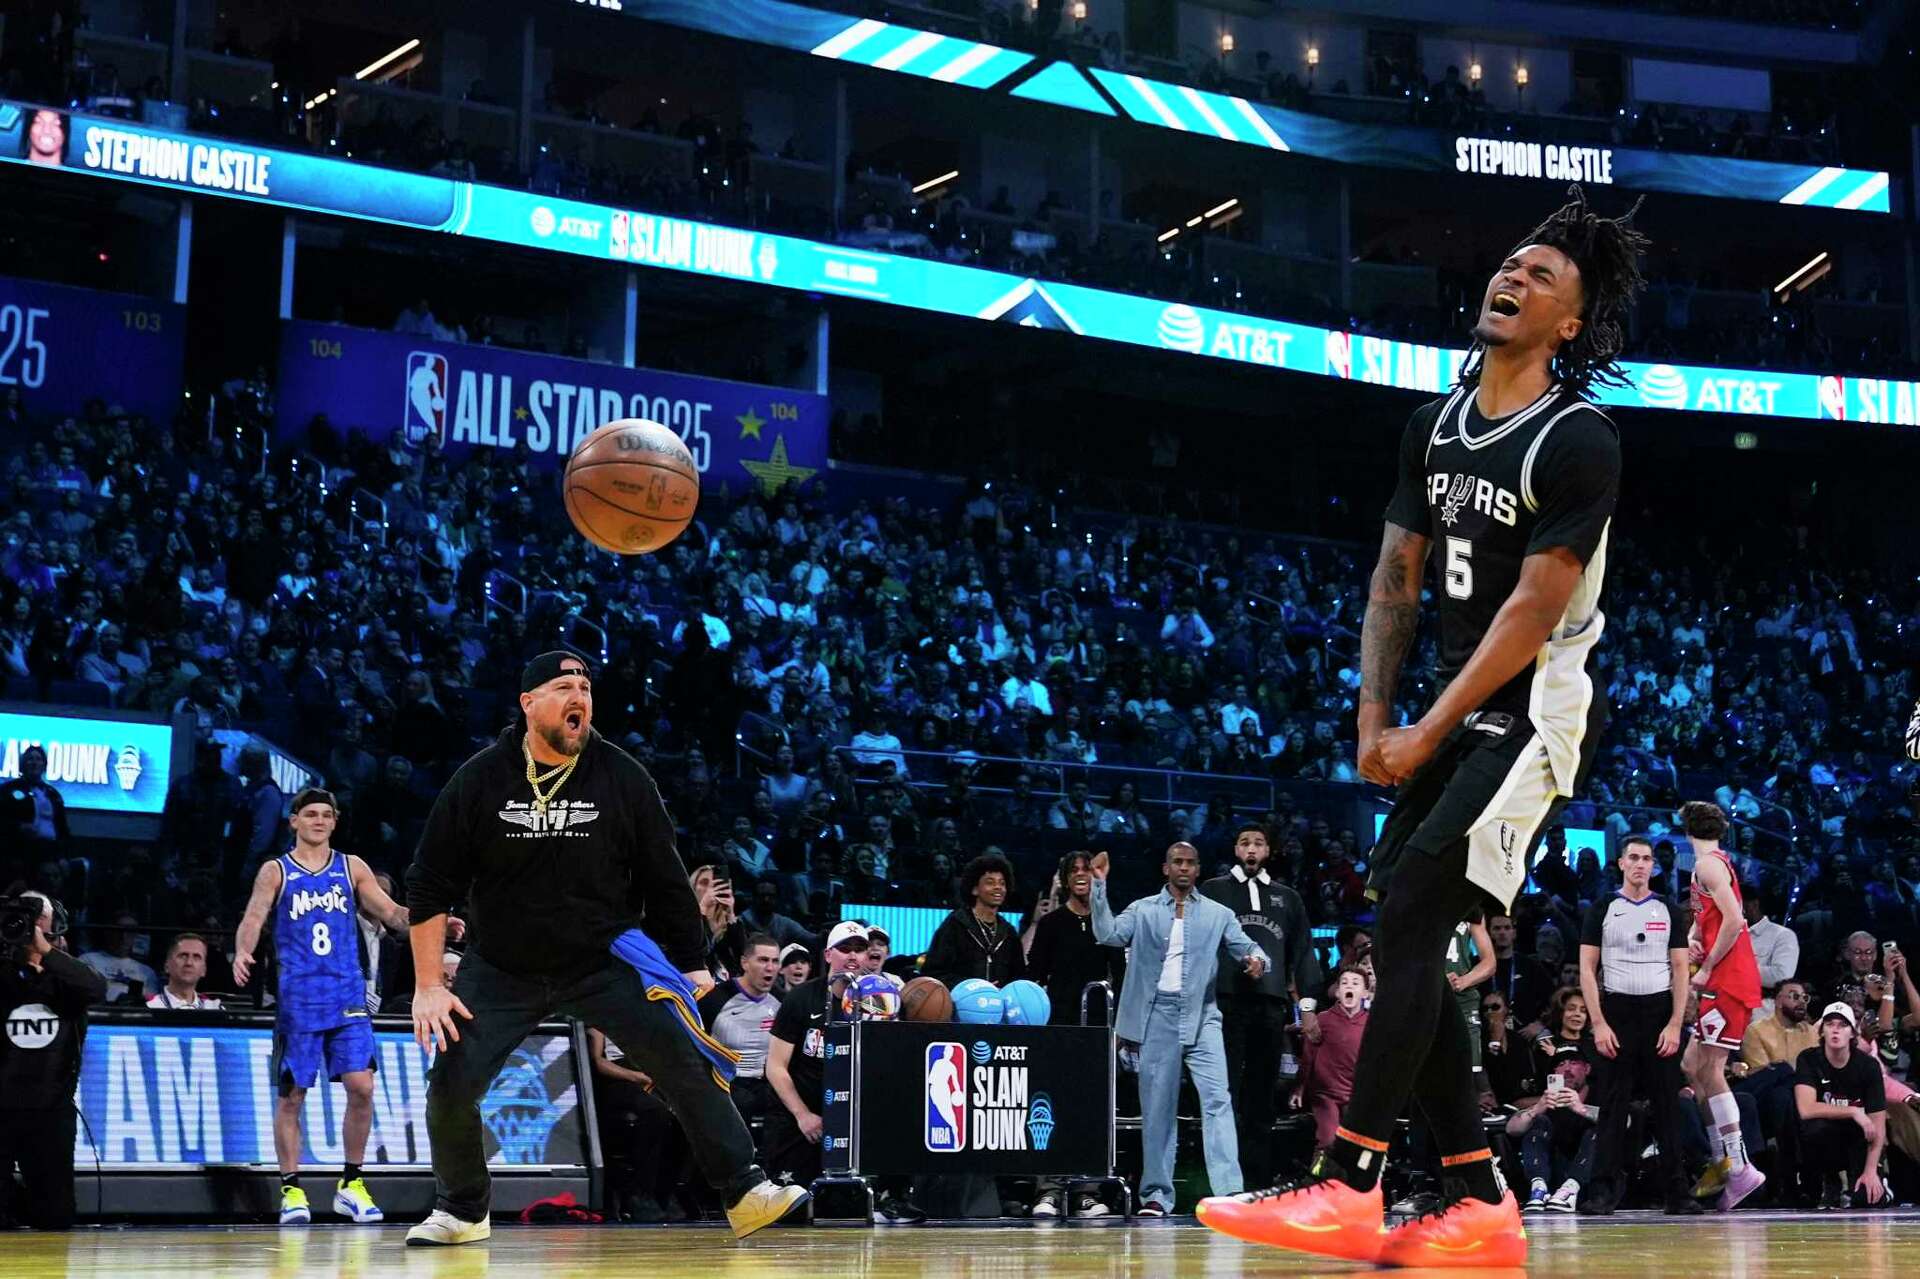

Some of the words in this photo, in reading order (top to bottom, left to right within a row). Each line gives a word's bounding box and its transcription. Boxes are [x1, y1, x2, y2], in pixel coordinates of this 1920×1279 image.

[84, 126, 189, 182] STEPHON
[191, 144, 272, 195] CASTLE
[1456, 137, 1541, 178] STEPHON
[1545, 144, 1613, 184] CASTLE
[558, 217, 601, 240] AT&T
[631, 213, 692, 268] SLAM
[695, 224, 754, 277] DUNK
[124, 311, 160, 333] 103
[309, 339, 342, 360] 104
[1211, 323, 1292, 367] AT&T
[452, 370, 517, 448] ALL
[770, 403, 798, 421] 104
[1700, 379, 1781, 415] AT&T
[1858, 377, 1920, 426] SLA
[1445, 536, 1474, 600] 5
[46, 742, 110, 784] DUNK
[312, 922, 332, 956] 8
[7, 1018, 58, 1035] TNT
[993, 1046, 1028, 1060] AT&T
[973, 1066, 1028, 1108] SLAM
[931, 1126, 951, 1144] NBA
[973, 1109, 1028, 1150] DUNK
